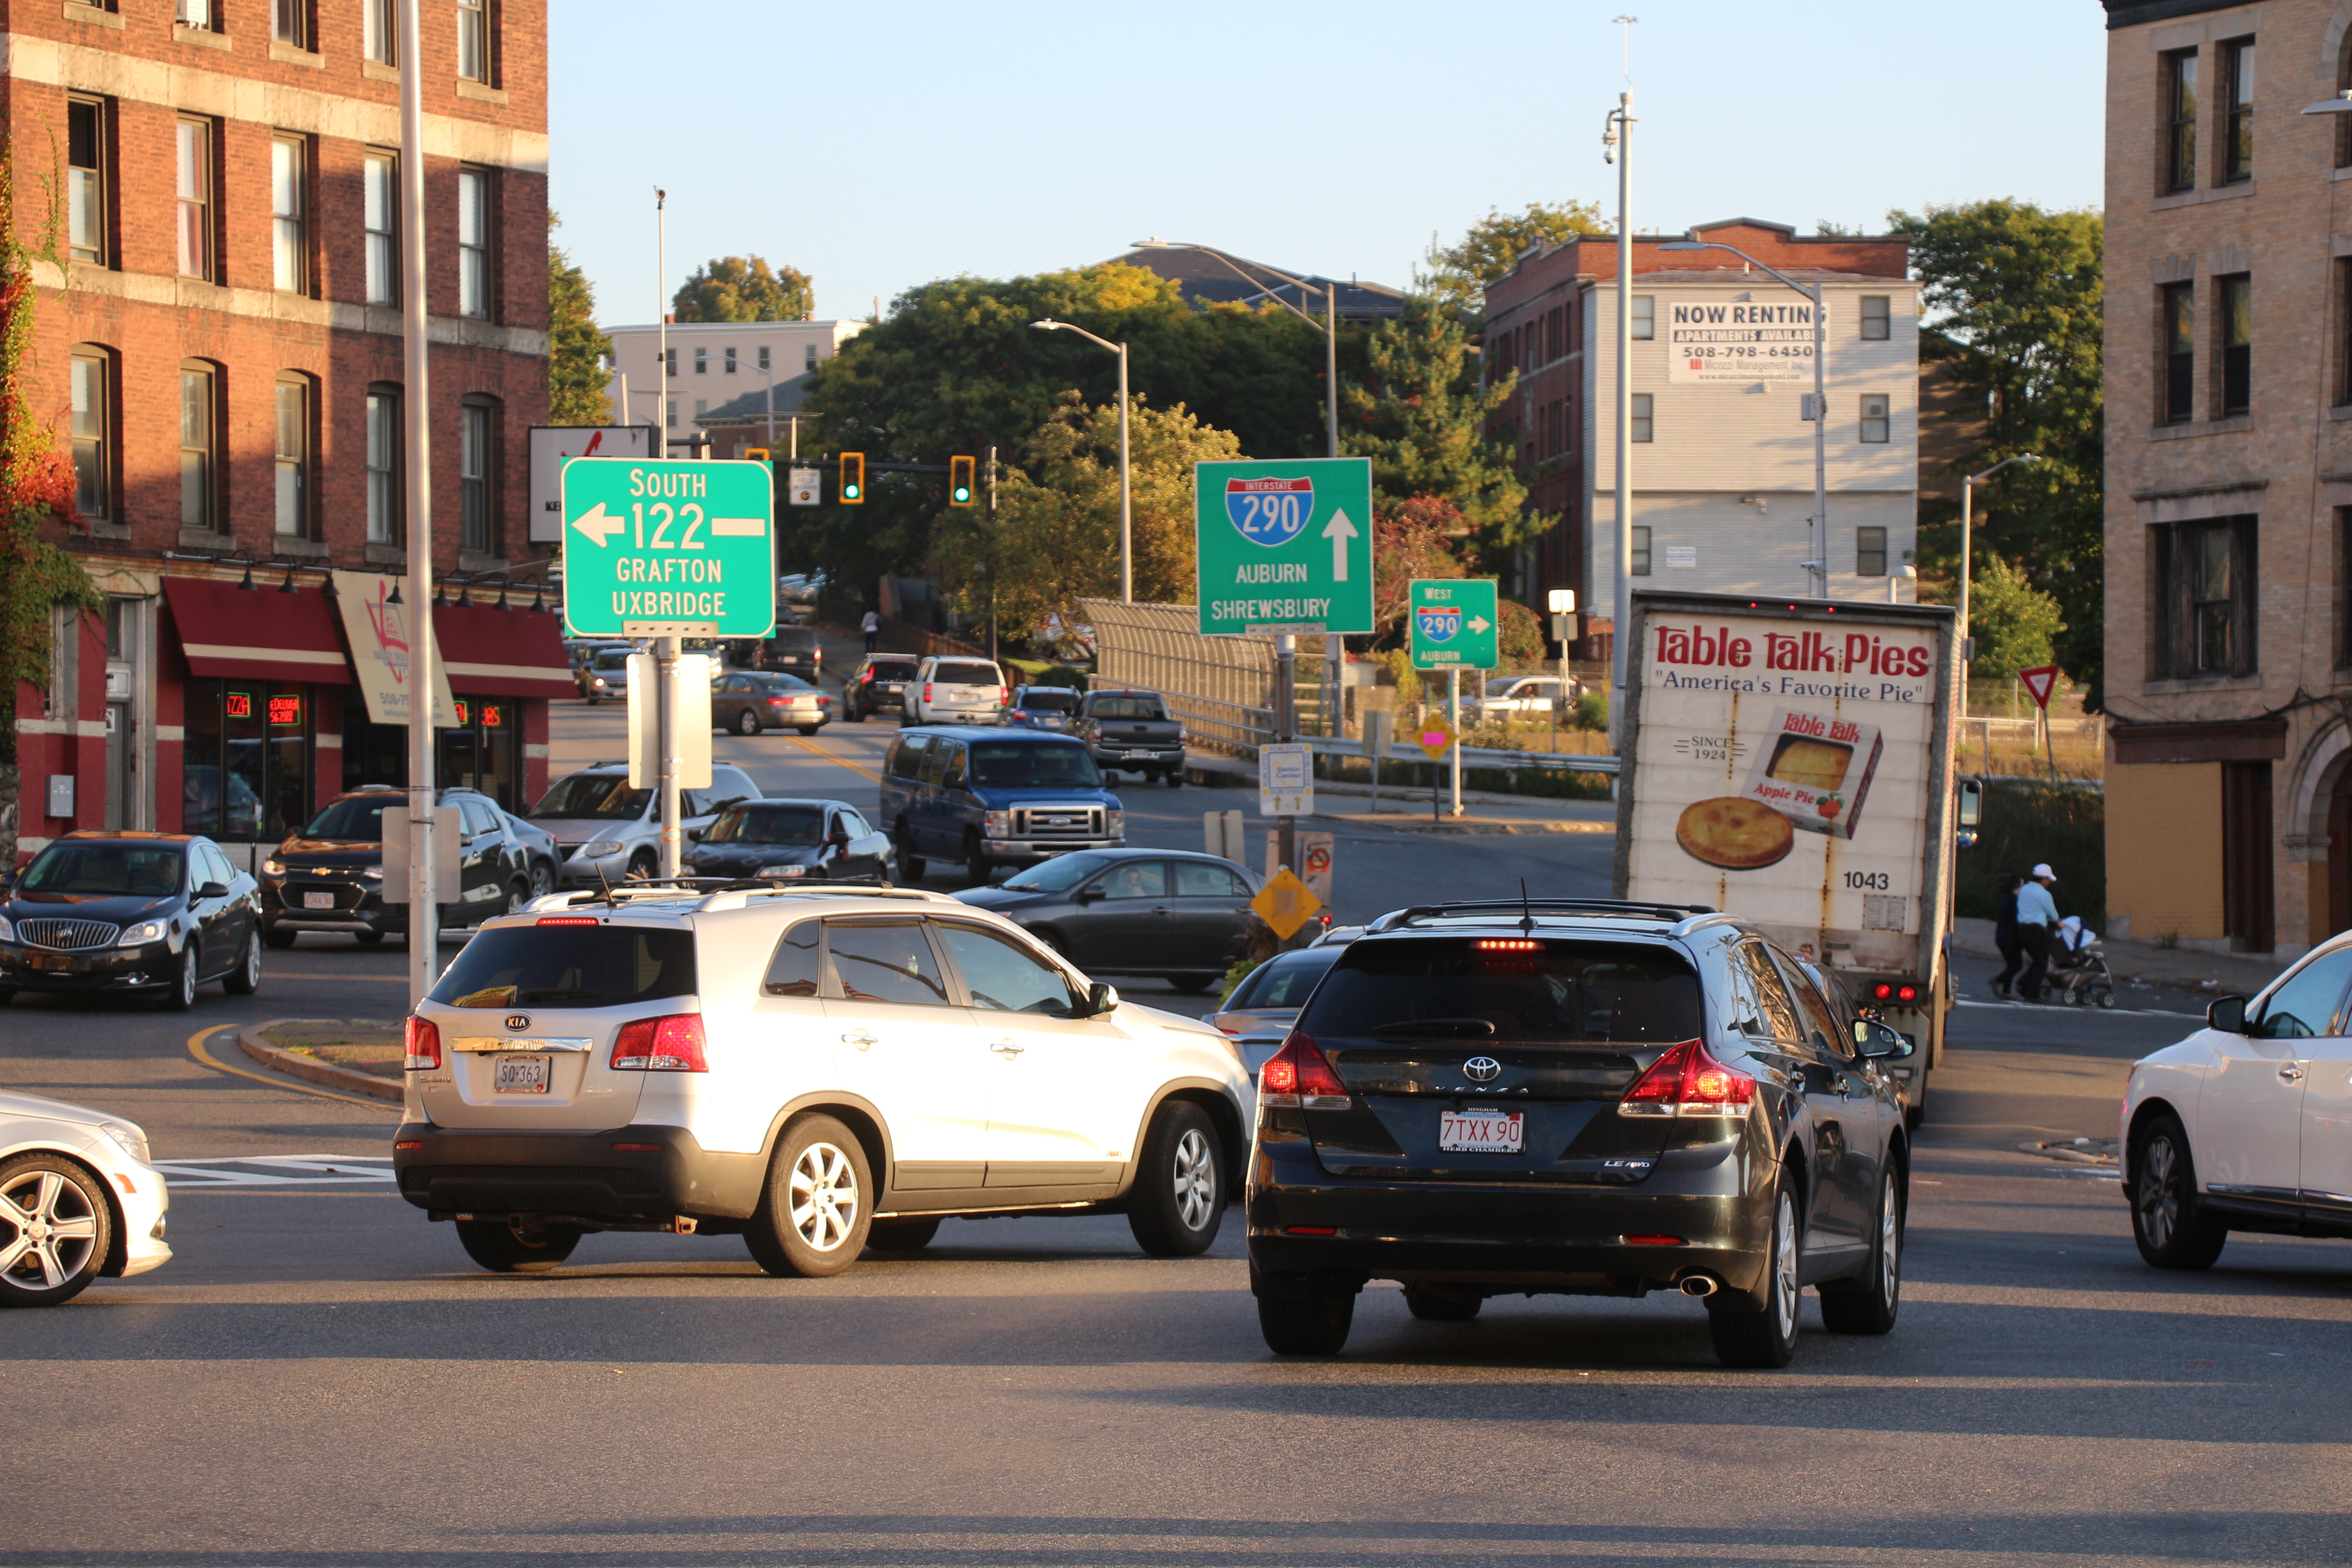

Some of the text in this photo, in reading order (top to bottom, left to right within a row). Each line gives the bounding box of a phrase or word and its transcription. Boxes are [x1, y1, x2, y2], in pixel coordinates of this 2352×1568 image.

[1675, 305, 1726, 323] NOW
[1678, 329, 1825, 341] APARTMENTS AVAILAB
[1683, 346, 1813, 357] 508-798-6450
[1737, 359, 1788, 371] Management
[629, 468, 706, 498] SOUTH
[1245, 481, 1294, 491] INTERSTATE
[1242, 495, 1300, 533] 290
[632, 502, 705, 549] 122
[616, 557, 722, 583] GRAFTON
[1235, 563, 1308, 583] AUBURN
[1425, 588, 1452, 599] WEST
[612, 591, 726, 616] UXBRIDGE
[1211, 598, 1331, 620] SHREWSBURY
[1424, 617, 1457, 634] 290
[1420, 651, 1460, 662] AUBURN
[1655, 625, 1930, 677] Table Talk Pies
[1780, 676, 1871, 699] Favorite
[1783, 712, 1862, 744] Table Talk
[1691, 736, 1732, 748] SINCE
[1695, 749, 1726, 760] 1924
[1754, 782, 1792, 799] Apple
[1793, 789, 1815, 804] Pie
[1843, 871, 1890, 890] 1043
[508, 1017, 526, 1027] KIA
[1443, 1119, 1519, 1142] 7TXX 90
